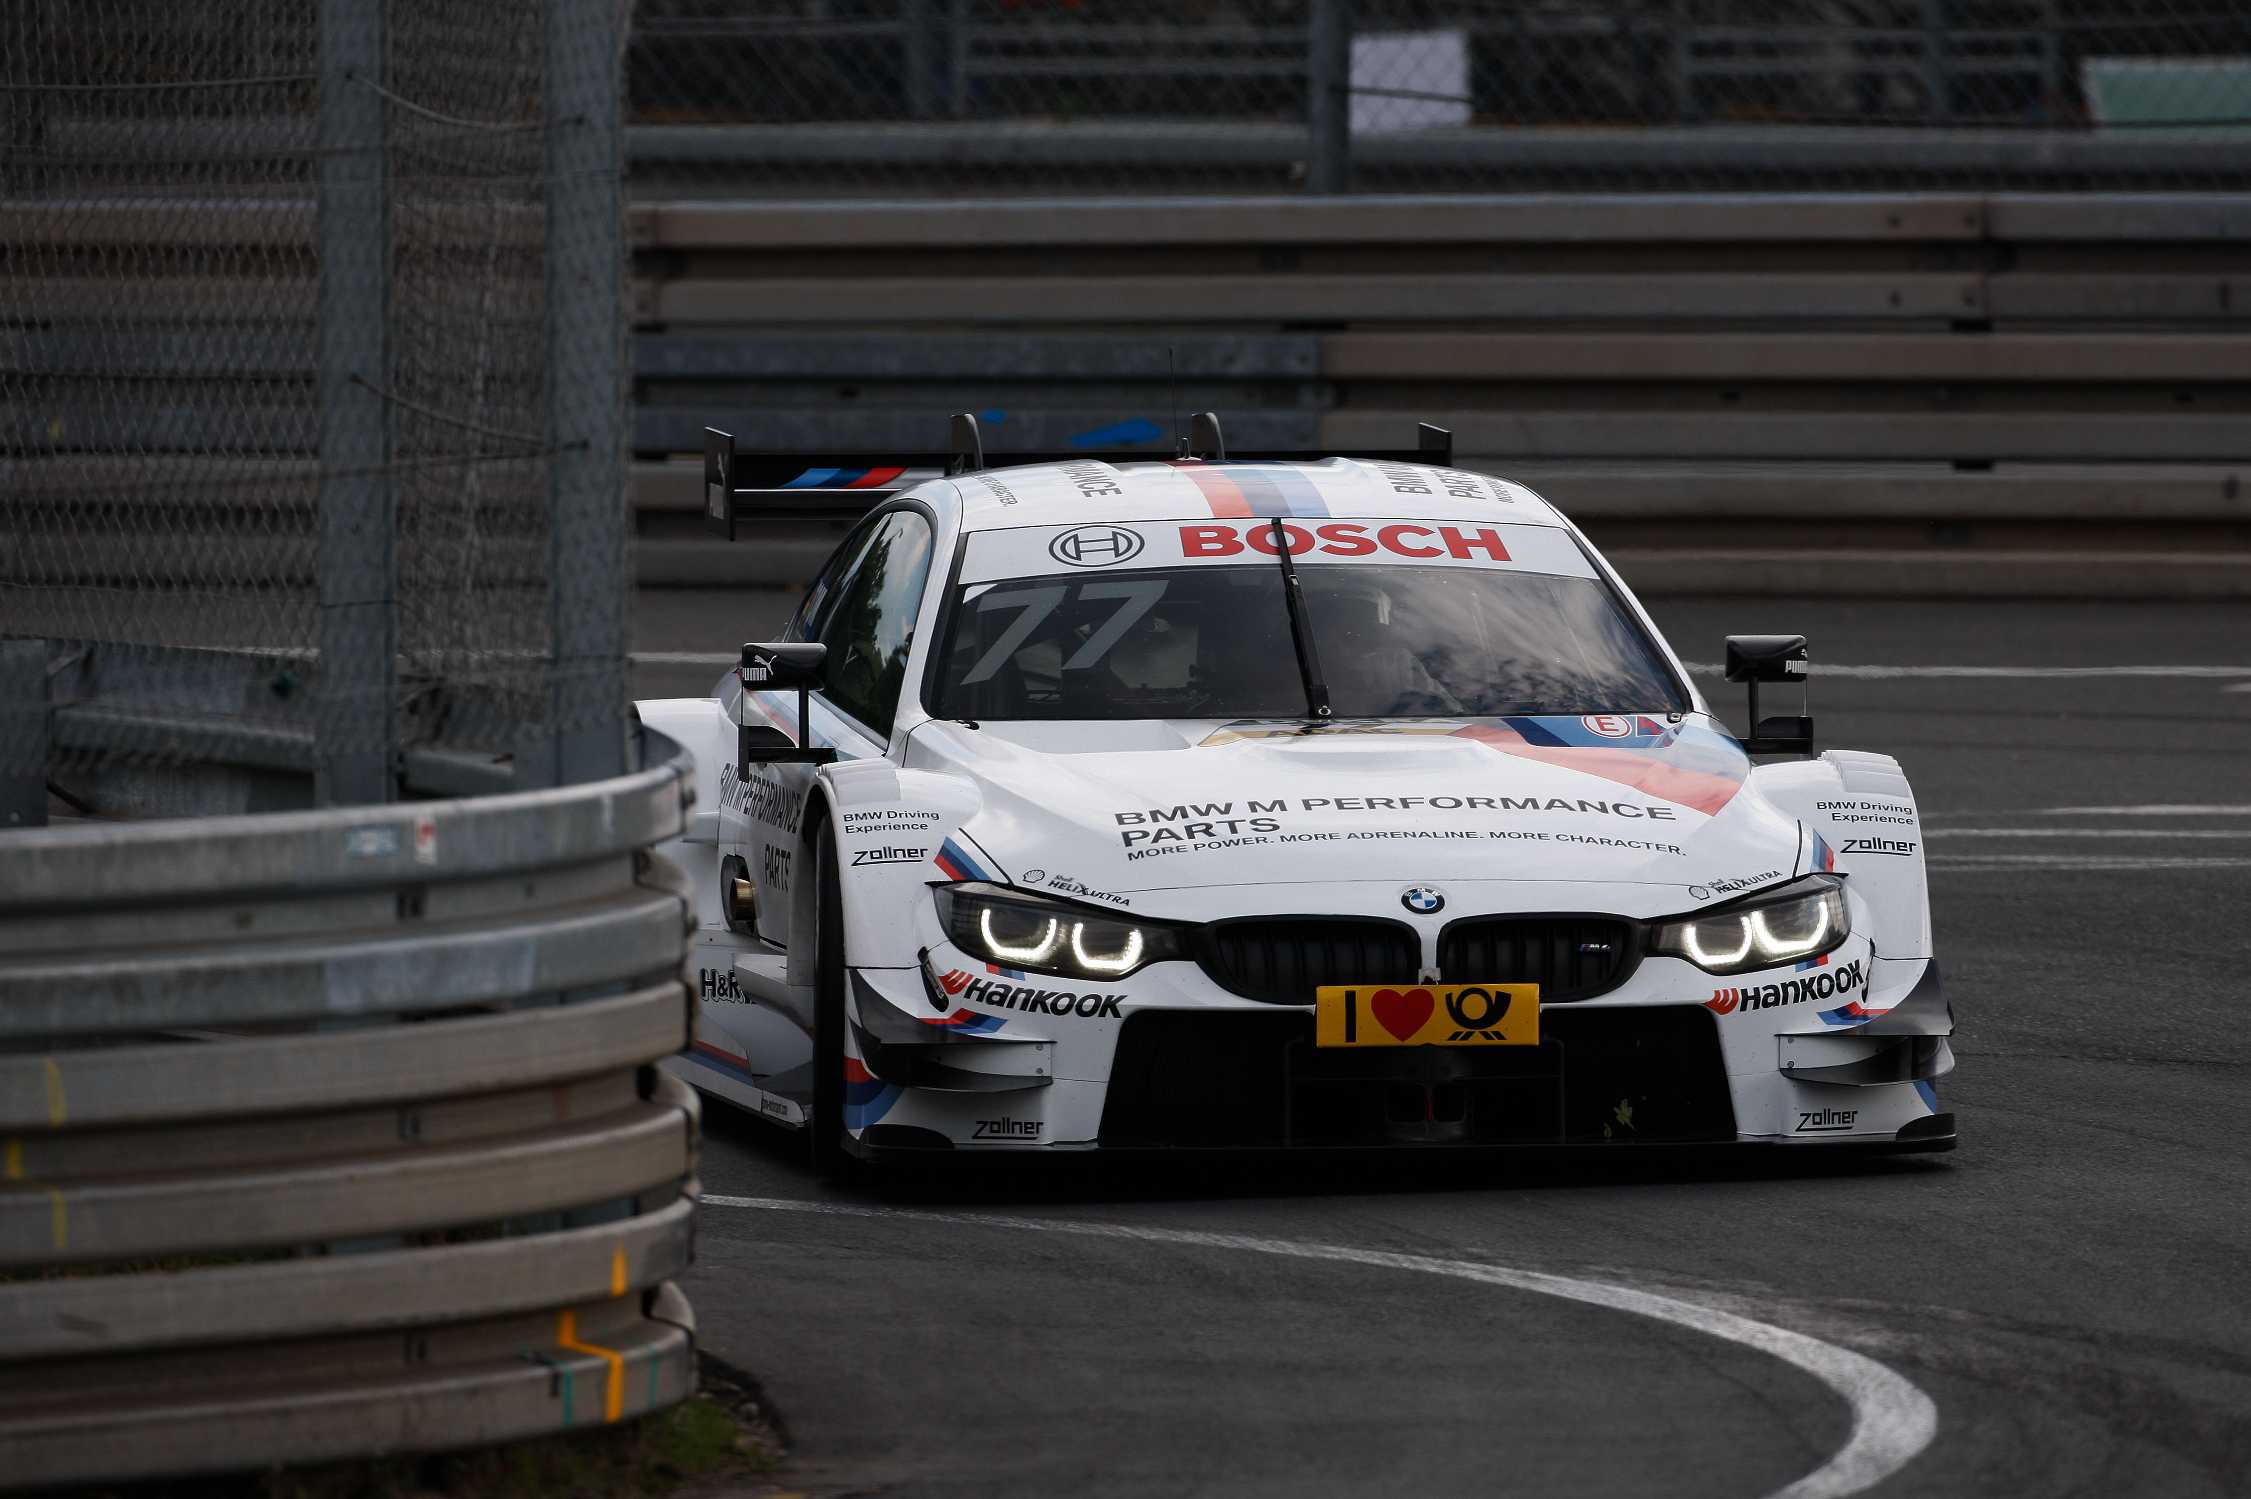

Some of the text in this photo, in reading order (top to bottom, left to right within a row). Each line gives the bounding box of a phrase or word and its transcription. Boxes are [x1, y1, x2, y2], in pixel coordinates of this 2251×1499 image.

[1178, 523, 1513, 562] BOSCH
[960, 579, 1170, 686] 77
[742, 667, 767, 681] UMA
[843, 810, 940, 822] BMW Driving
[1115, 796, 1677, 826] BMW M PERFORMANCE
[1816, 801, 1913, 815] BMW Driving
[1831, 812, 1914, 825] Experience
[845, 822, 929, 834] Experience
[1121, 817, 1281, 848] PARTS
[1127, 831, 1687, 862] MORE POWER. MORE ADRENALINE. MORE CHARACTER.
[764, 844, 791, 892] PARTS
[1749, 870, 1783, 884] ULTRA
[1090, 890, 1131, 906] ULTRA
[1344, 989, 1357, 1044] I
